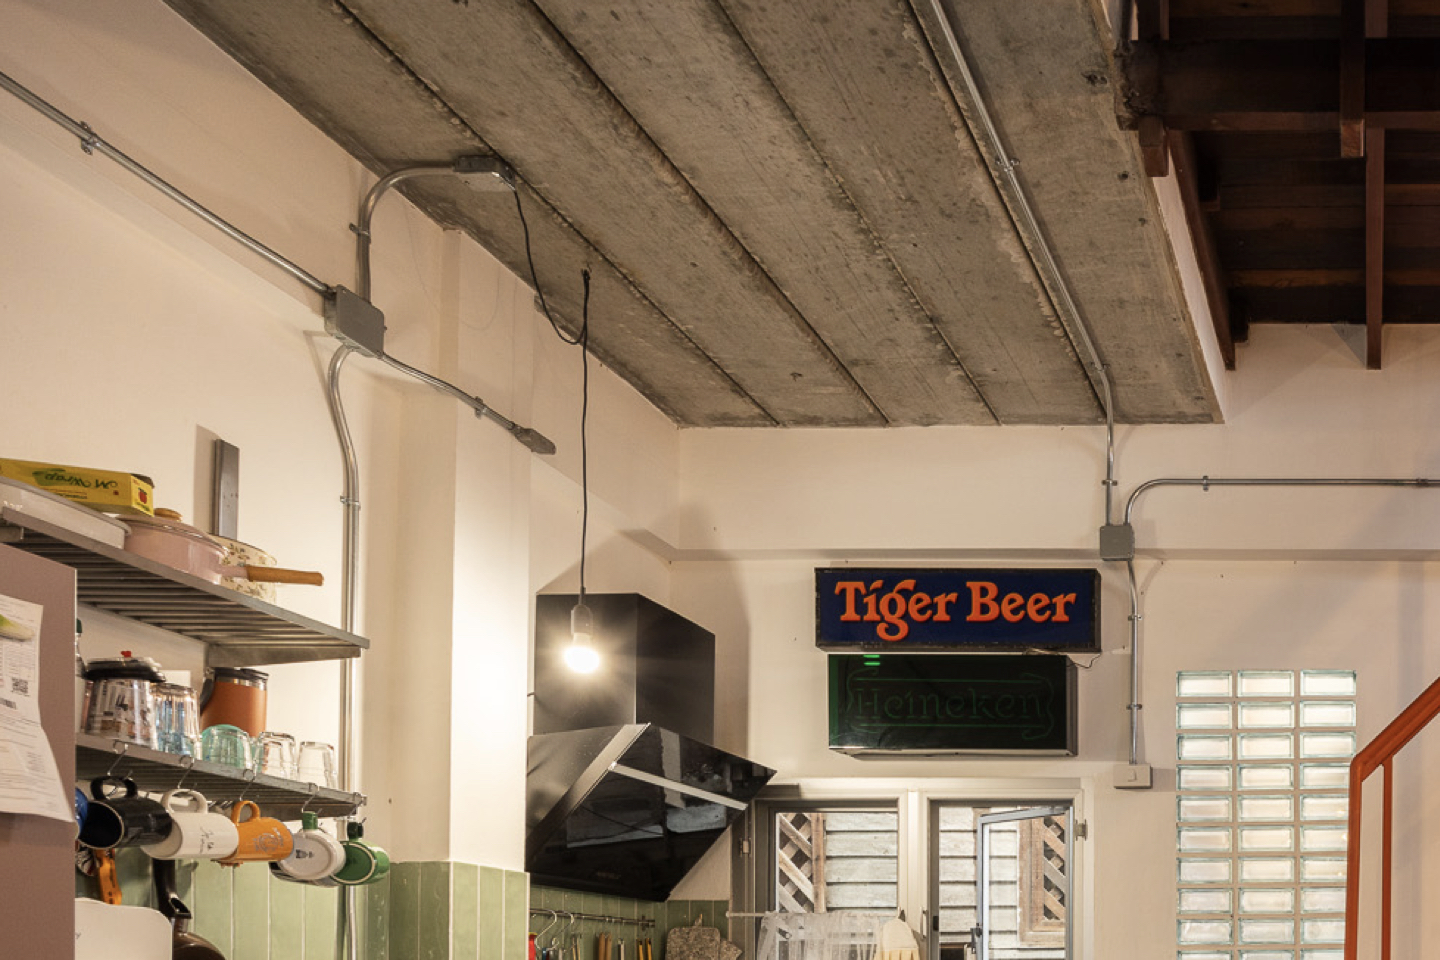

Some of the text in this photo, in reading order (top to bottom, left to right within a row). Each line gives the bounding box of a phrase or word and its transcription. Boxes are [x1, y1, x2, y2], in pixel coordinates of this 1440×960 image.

[45, 473, 92, 488] Wrap
[834, 578, 1077, 642] Tiger Beer
[855, 688, 1044, 720] Heineken
